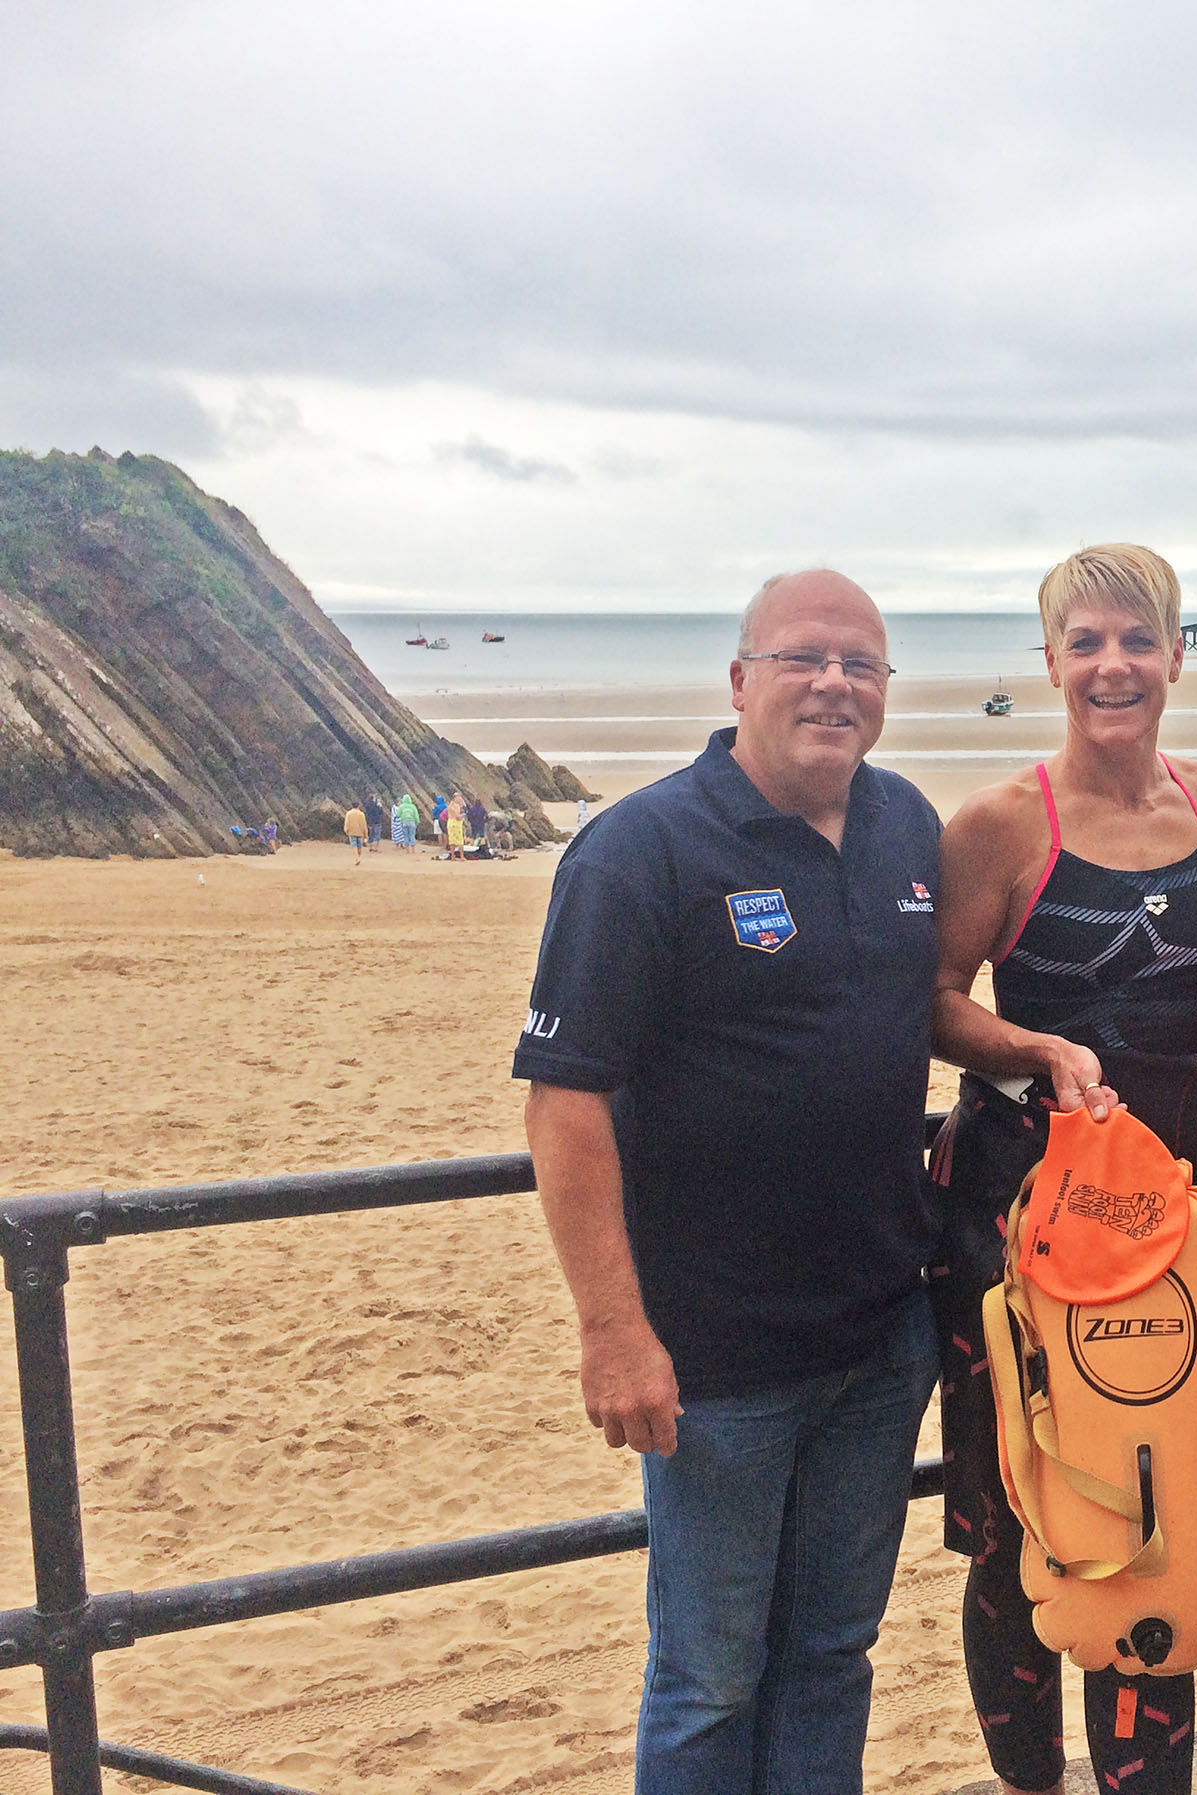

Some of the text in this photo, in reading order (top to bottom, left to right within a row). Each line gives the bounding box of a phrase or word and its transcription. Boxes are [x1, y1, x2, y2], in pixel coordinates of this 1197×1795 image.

[734, 895, 780, 916] RESPECT
[897, 899, 934, 912] Lifeboats
[741, 916, 788, 934] THE WATER
[1048, 1169, 1072, 1225] tenfoot swim
[1067, 1184, 1096, 1217] SWIM
[1088, 1188, 1117, 1225] FOOT
[1109, 1193, 1141, 1234] TEN
[1083, 1318, 1184, 1342] ZONE3
